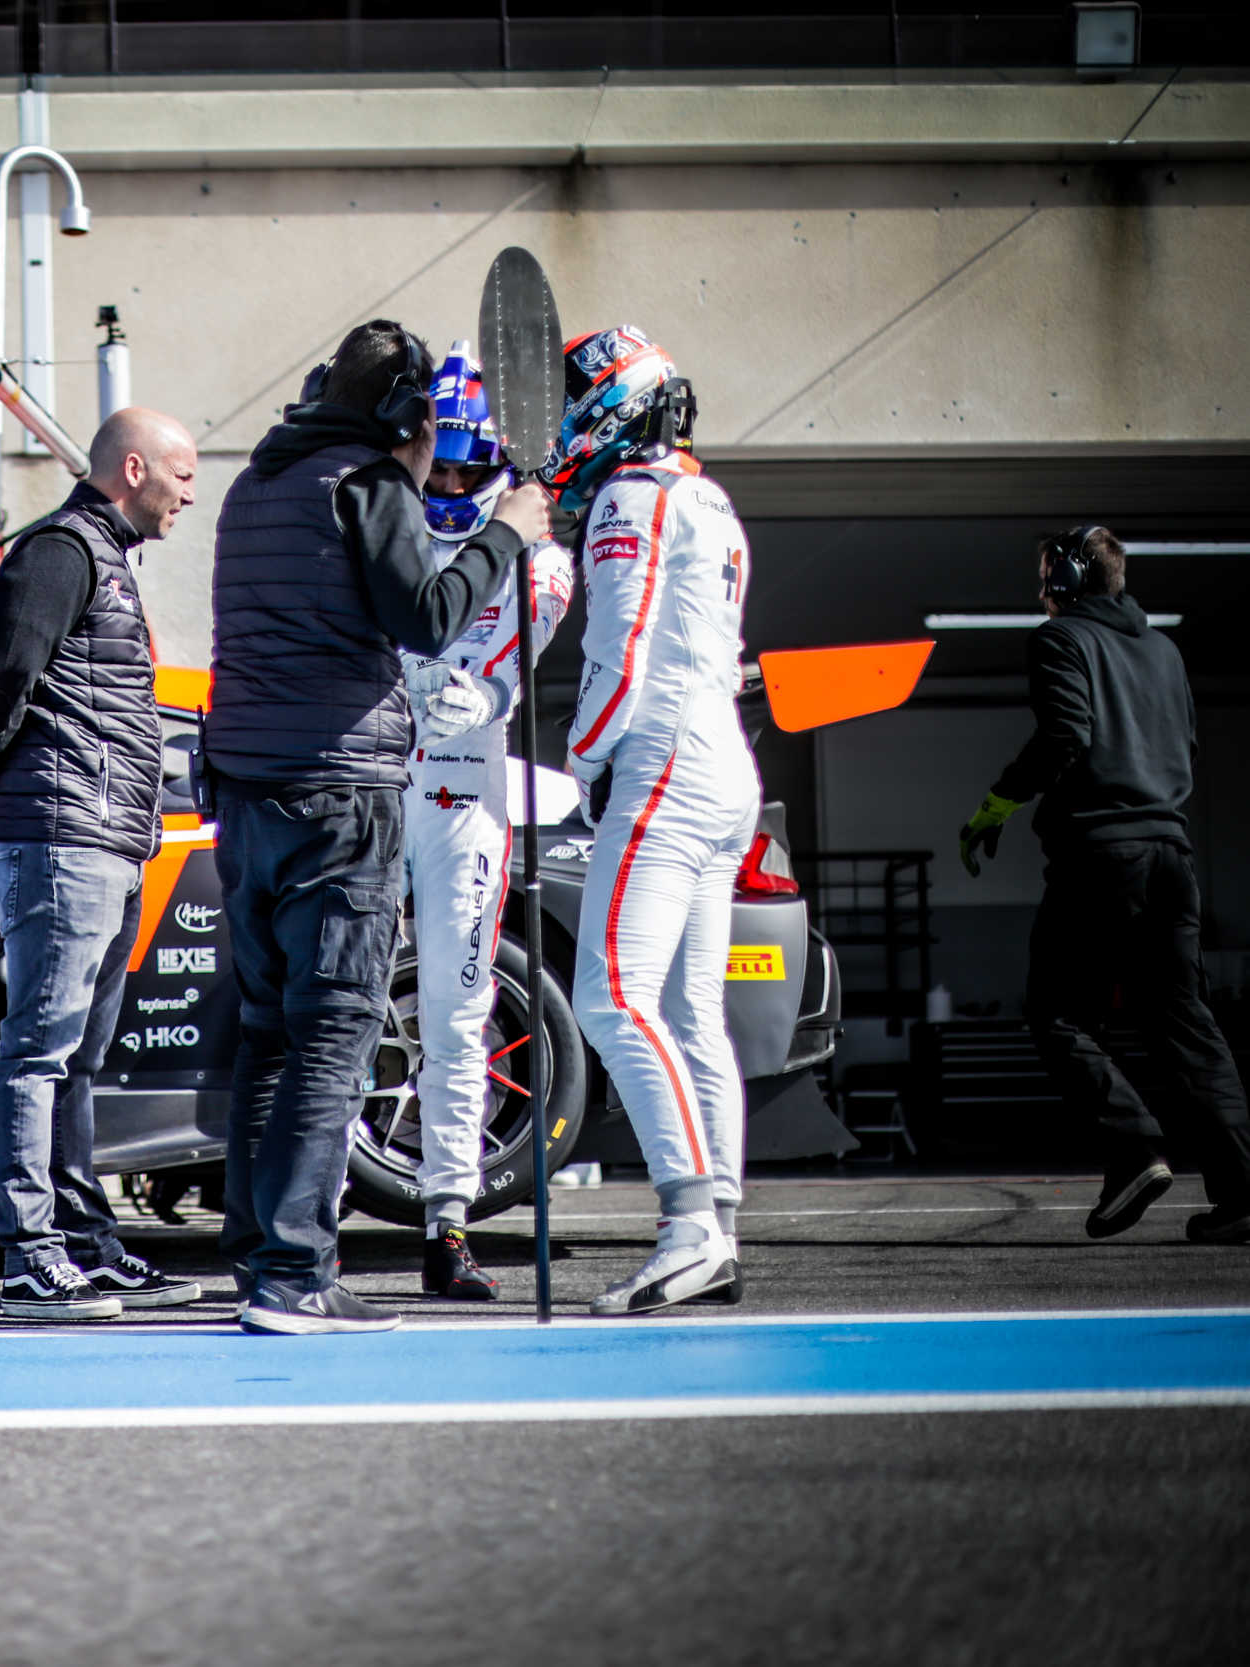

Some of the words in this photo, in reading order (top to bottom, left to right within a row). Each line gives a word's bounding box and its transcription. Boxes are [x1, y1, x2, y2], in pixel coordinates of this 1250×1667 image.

[593, 544, 636, 561] TOTAL
[157, 947, 217, 974] HEXIS
[145, 1024, 200, 1049] HKO
